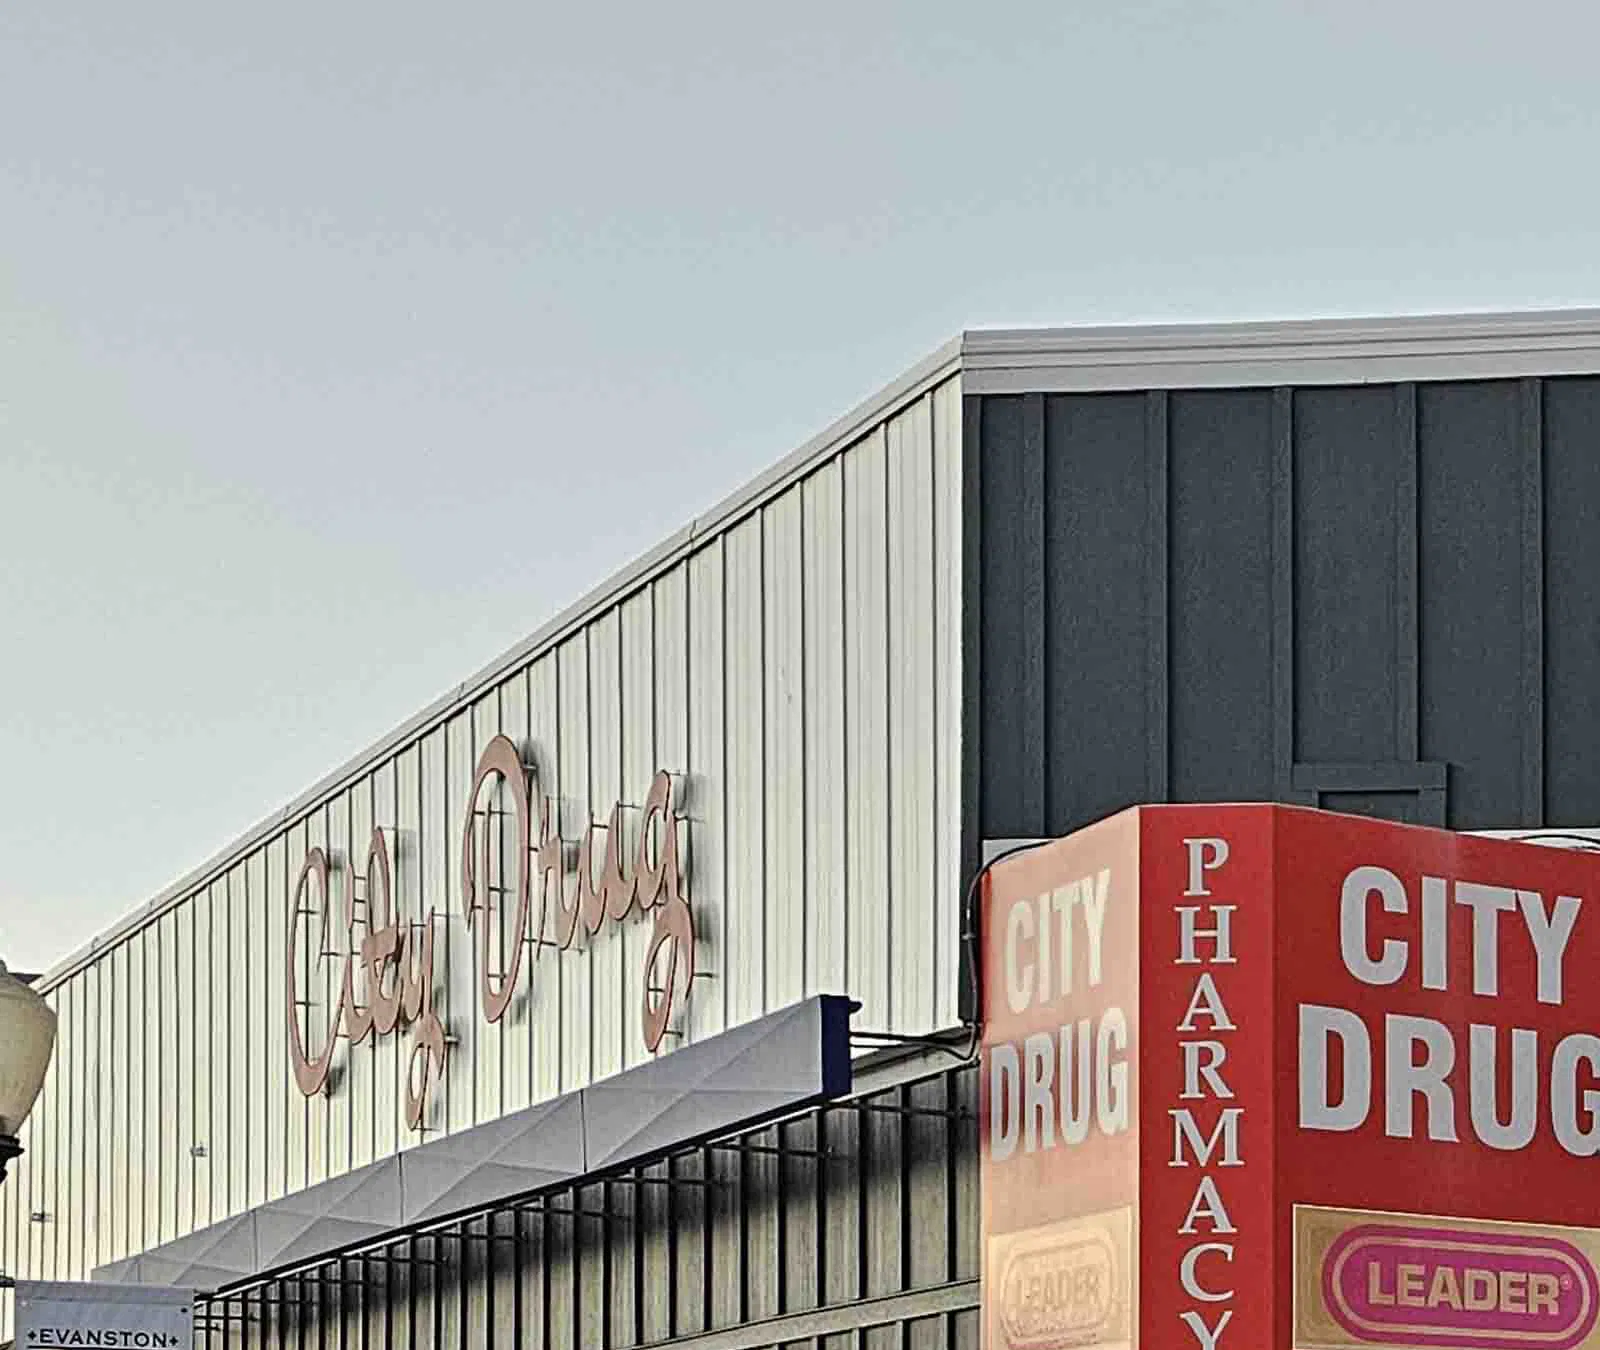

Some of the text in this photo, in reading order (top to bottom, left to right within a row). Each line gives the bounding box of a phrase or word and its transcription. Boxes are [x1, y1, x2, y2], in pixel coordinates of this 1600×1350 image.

[287, 735, 695, 1131] City Drug
[1005, 868, 1111, 1013] CITY
[1339, 865, 1583, 1005] CITY
[988, 1006, 1128, 1162] DRUG
[39, 1328, 168, 1348] EVANSTON
